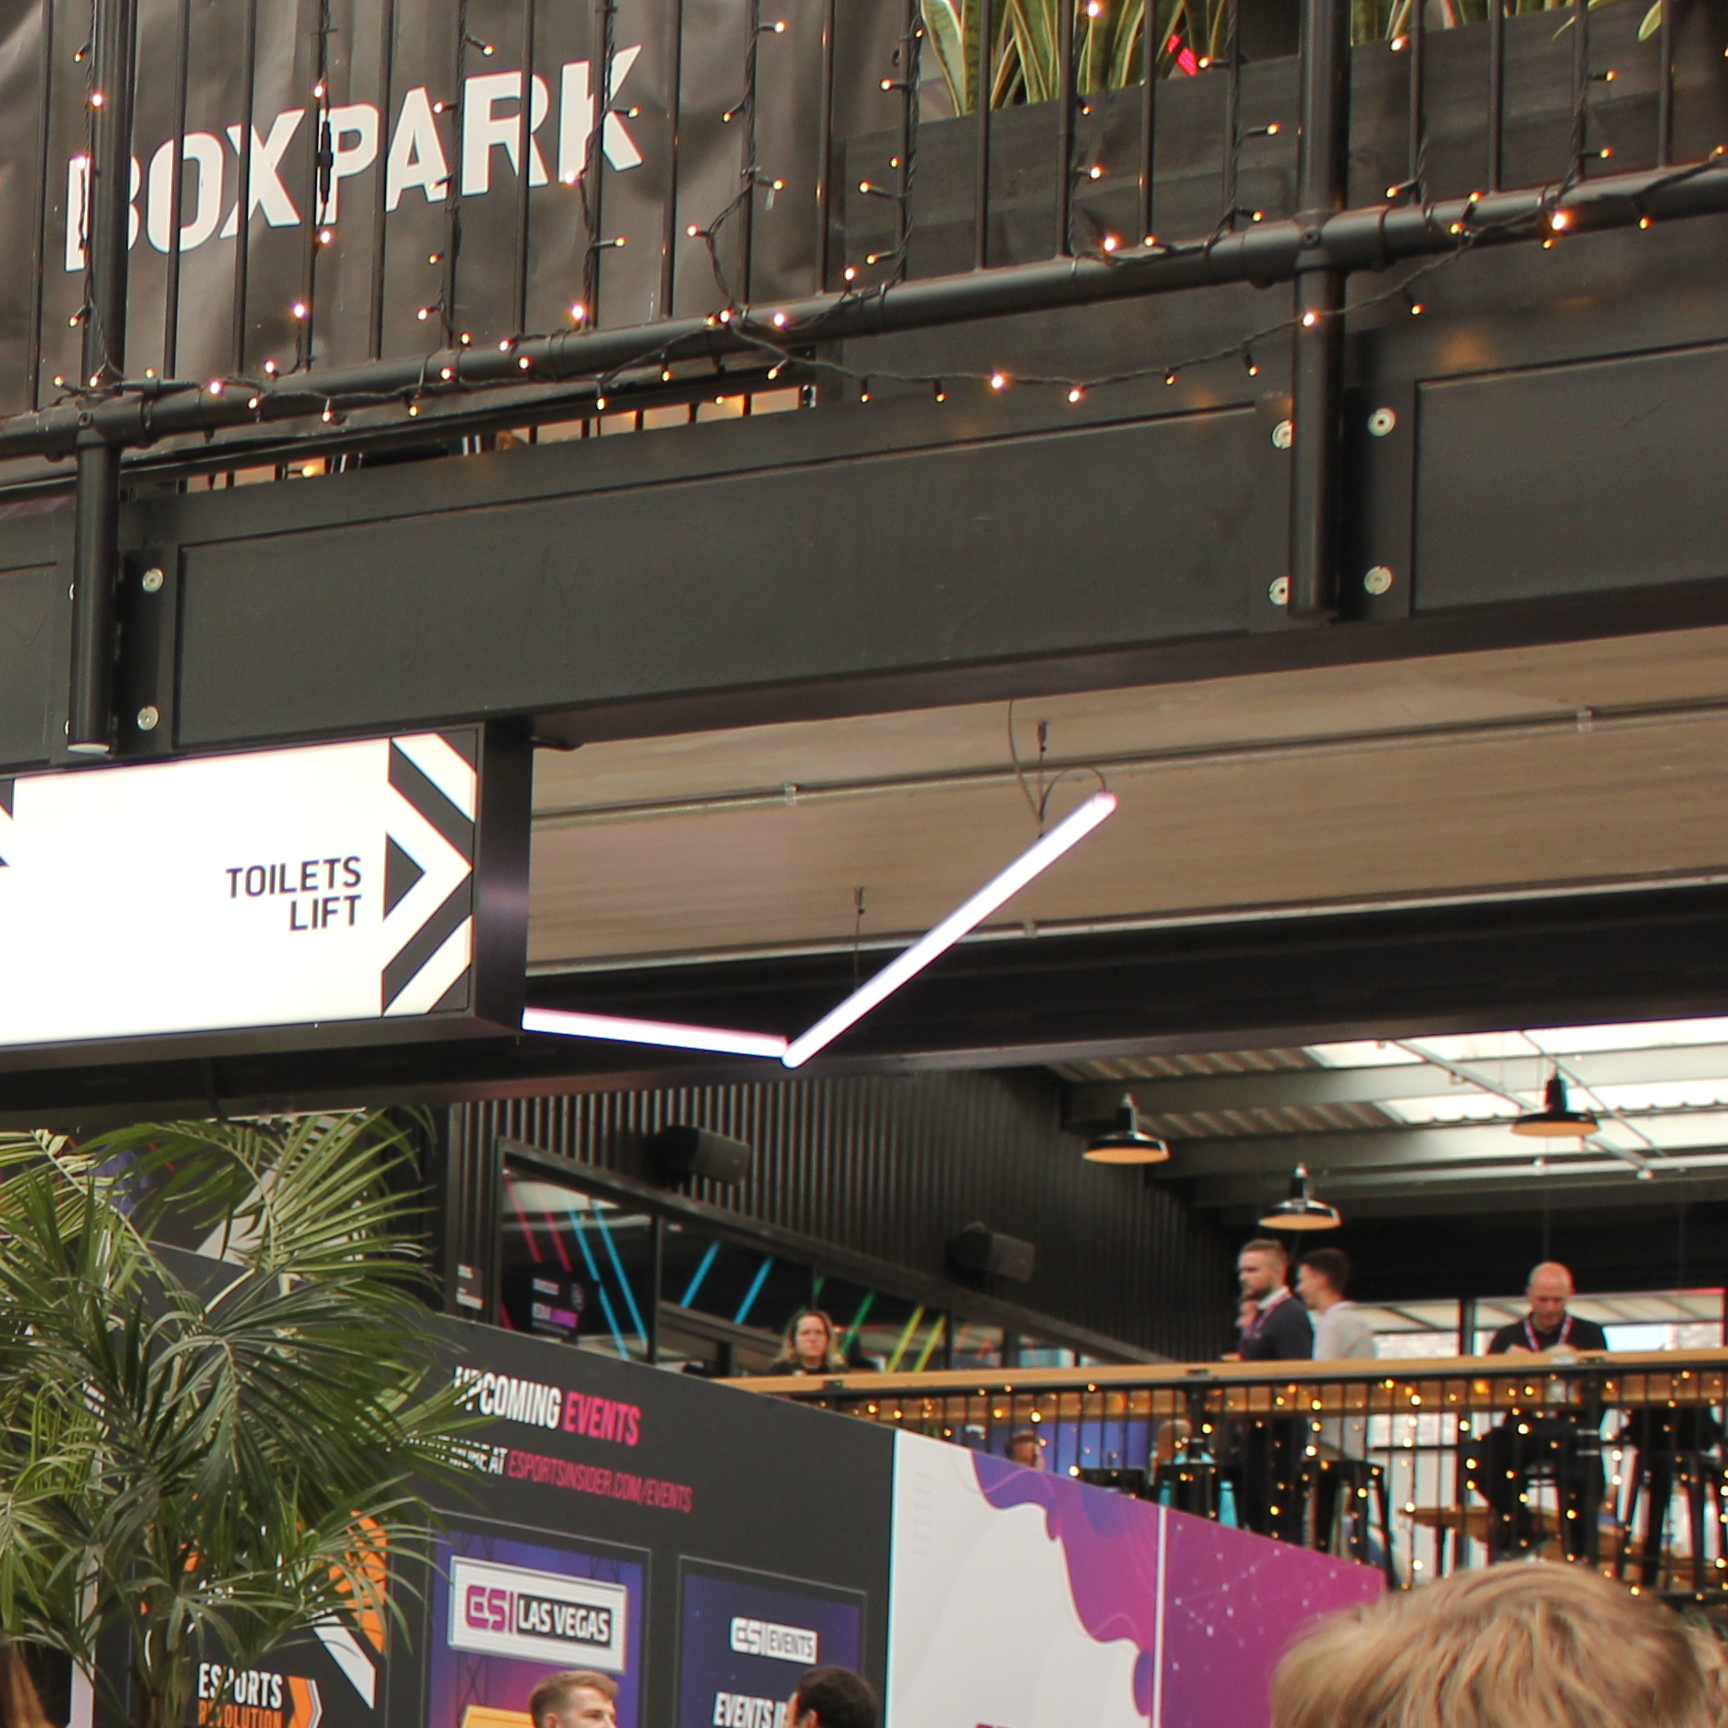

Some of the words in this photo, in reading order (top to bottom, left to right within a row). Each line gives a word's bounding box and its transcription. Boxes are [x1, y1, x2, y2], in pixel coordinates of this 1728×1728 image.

[65, 45, 642, 272] BOXPARK
[225, 856, 362, 899] TOILETS
[289, 894, 362, 931] LIFT
[562, 1391, 642, 1447] EVENTS
[518, 1599, 552, 1633] LAS
[553, 1605, 610, 1642] VEGAS
[769, 1623, 816, 1660] EVENTS
